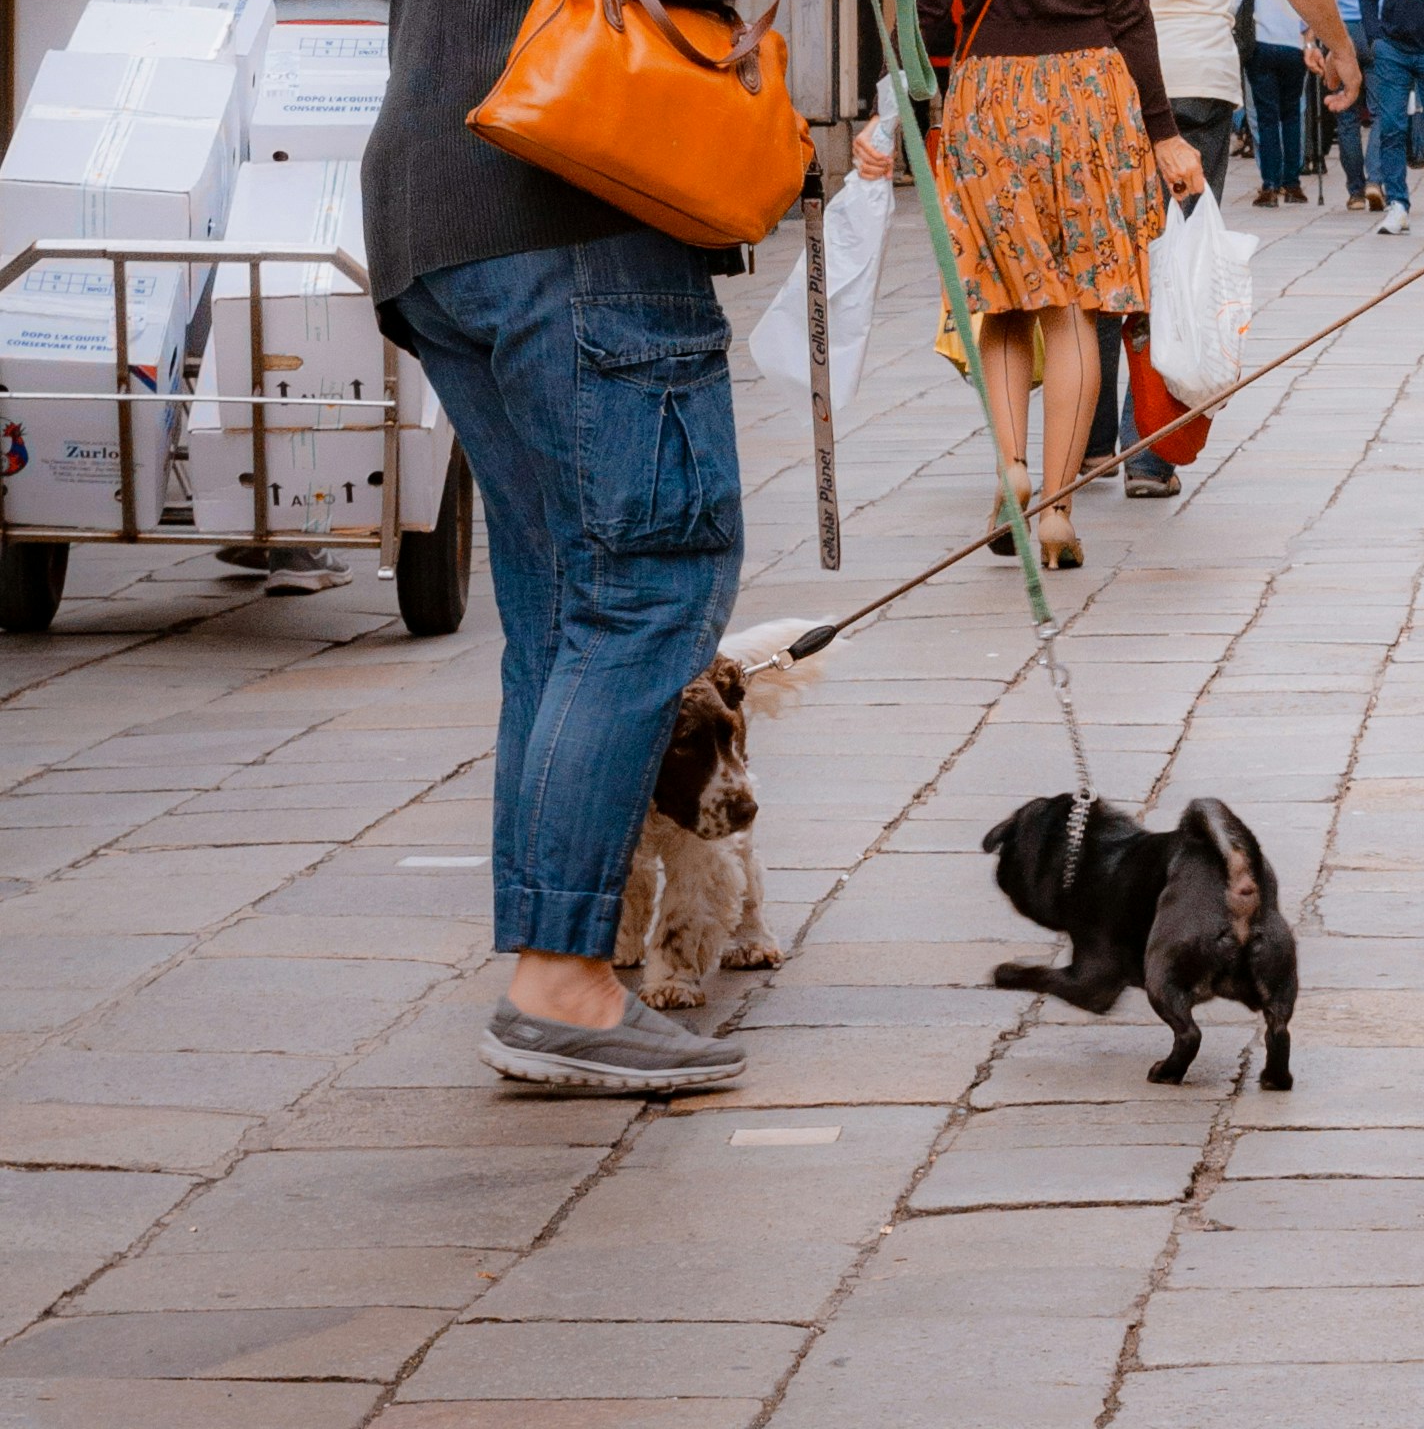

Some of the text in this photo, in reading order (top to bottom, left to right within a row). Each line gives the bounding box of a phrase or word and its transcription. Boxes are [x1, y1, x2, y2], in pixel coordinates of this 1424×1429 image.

[296, 95, 326, 103] DOPO
[283, 104, 346, 112] CONSERVARE
[809, 236, 827, 367] Cellular Planet
[21, 330, 52, 340] DOPO
[7, 339, 71, 350] CONSERVARE
[817, 448, 837, 571] Cellular Planet
